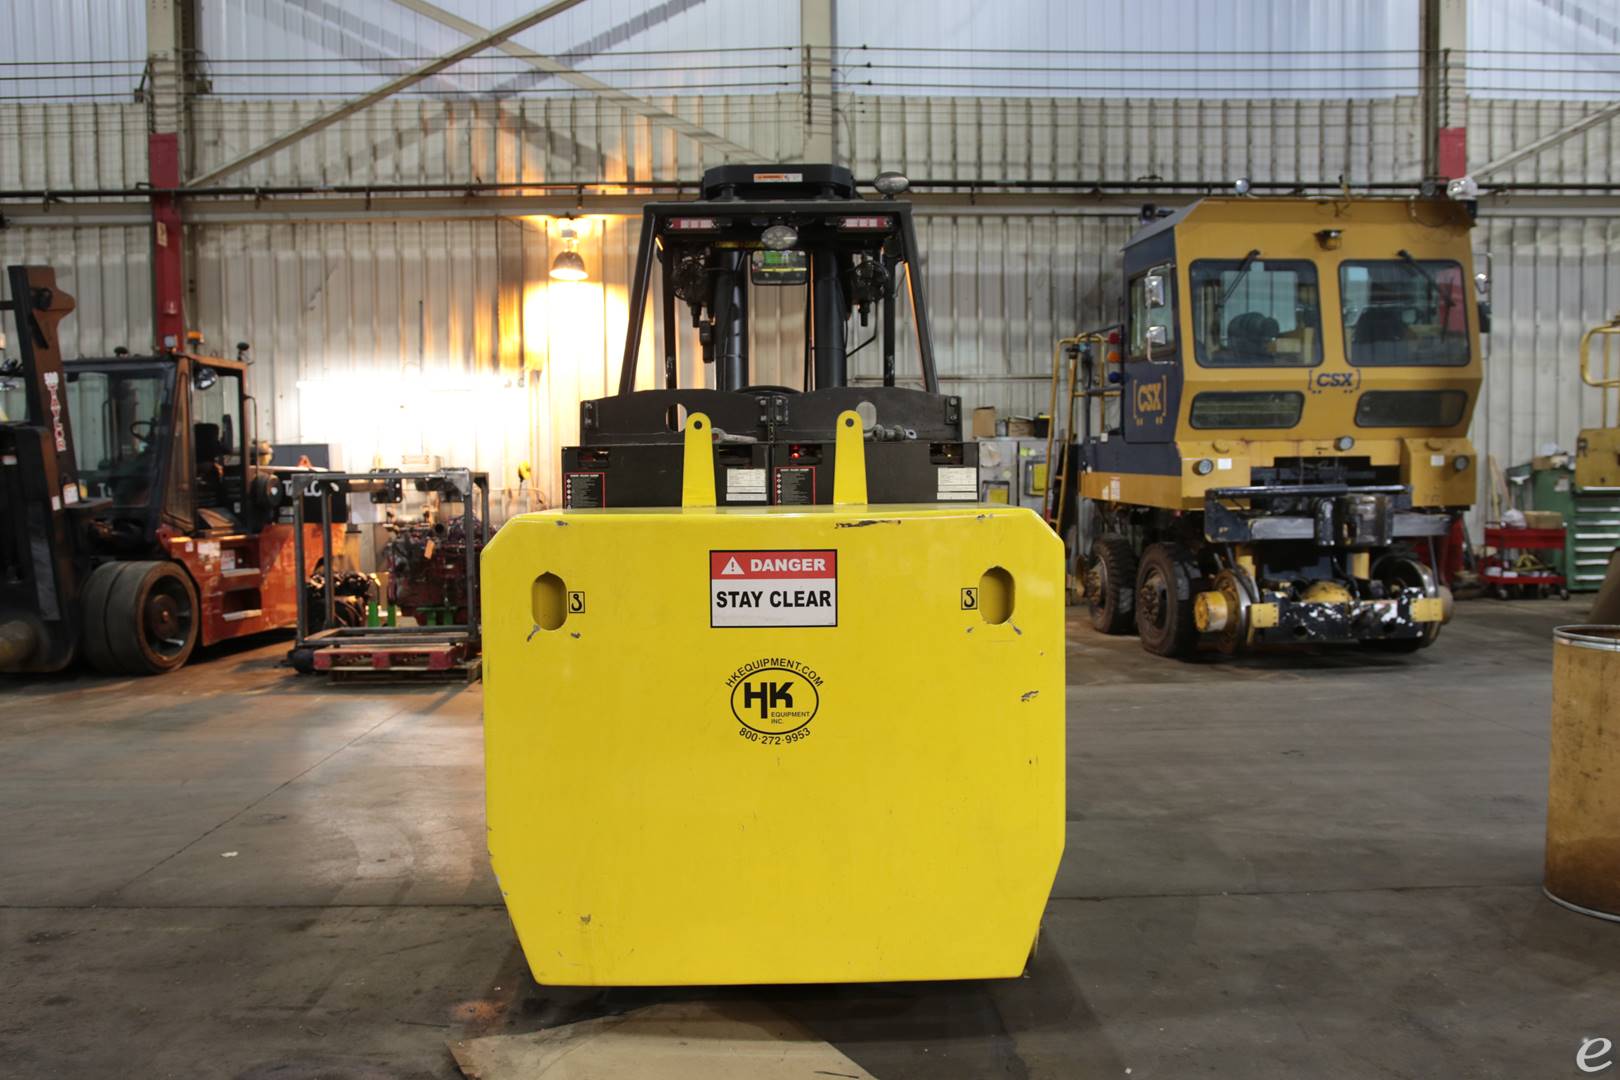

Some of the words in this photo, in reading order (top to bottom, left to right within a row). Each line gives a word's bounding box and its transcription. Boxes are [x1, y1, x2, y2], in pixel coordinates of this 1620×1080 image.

[1317, 372, 1352, 387] CSX
[1137, 382, 1162, 412] CSX
[750, 558, 826, 572] DANGER
[716, 590, 763, 608] STAY
[769, 590, 832, 608] CLEAR
[725, 657, 824, 688] HKEQUIPMENT.COM
[744, 682, 794, 719] HK
